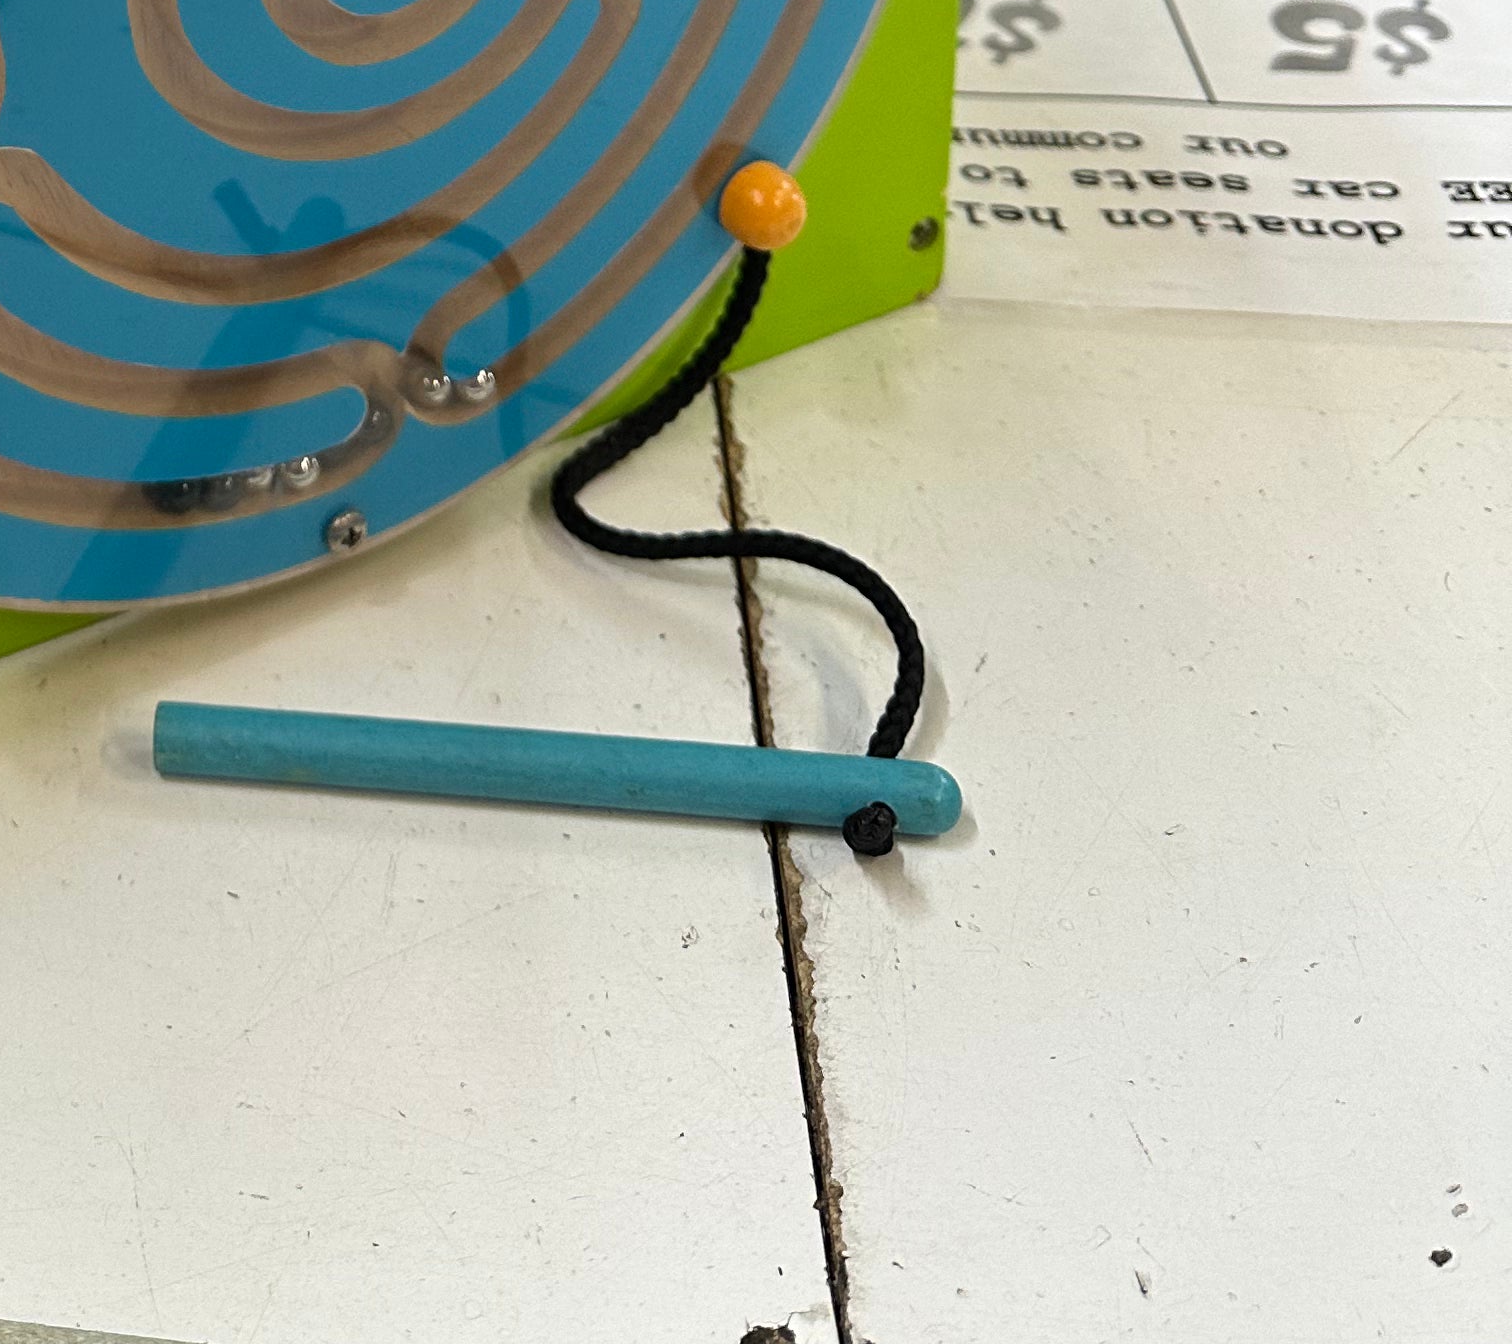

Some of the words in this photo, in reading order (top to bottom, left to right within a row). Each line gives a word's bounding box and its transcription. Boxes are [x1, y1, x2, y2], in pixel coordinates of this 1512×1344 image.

[1185, 133, 1289, 158] our
[959, 162, 1028, 189] to
[1072, 167, 1250, 193] seats
[1293, 178, 1400, 201] car
[946, 201, 1068, 234] hel
[1105, 209, 1404, 244] donation
